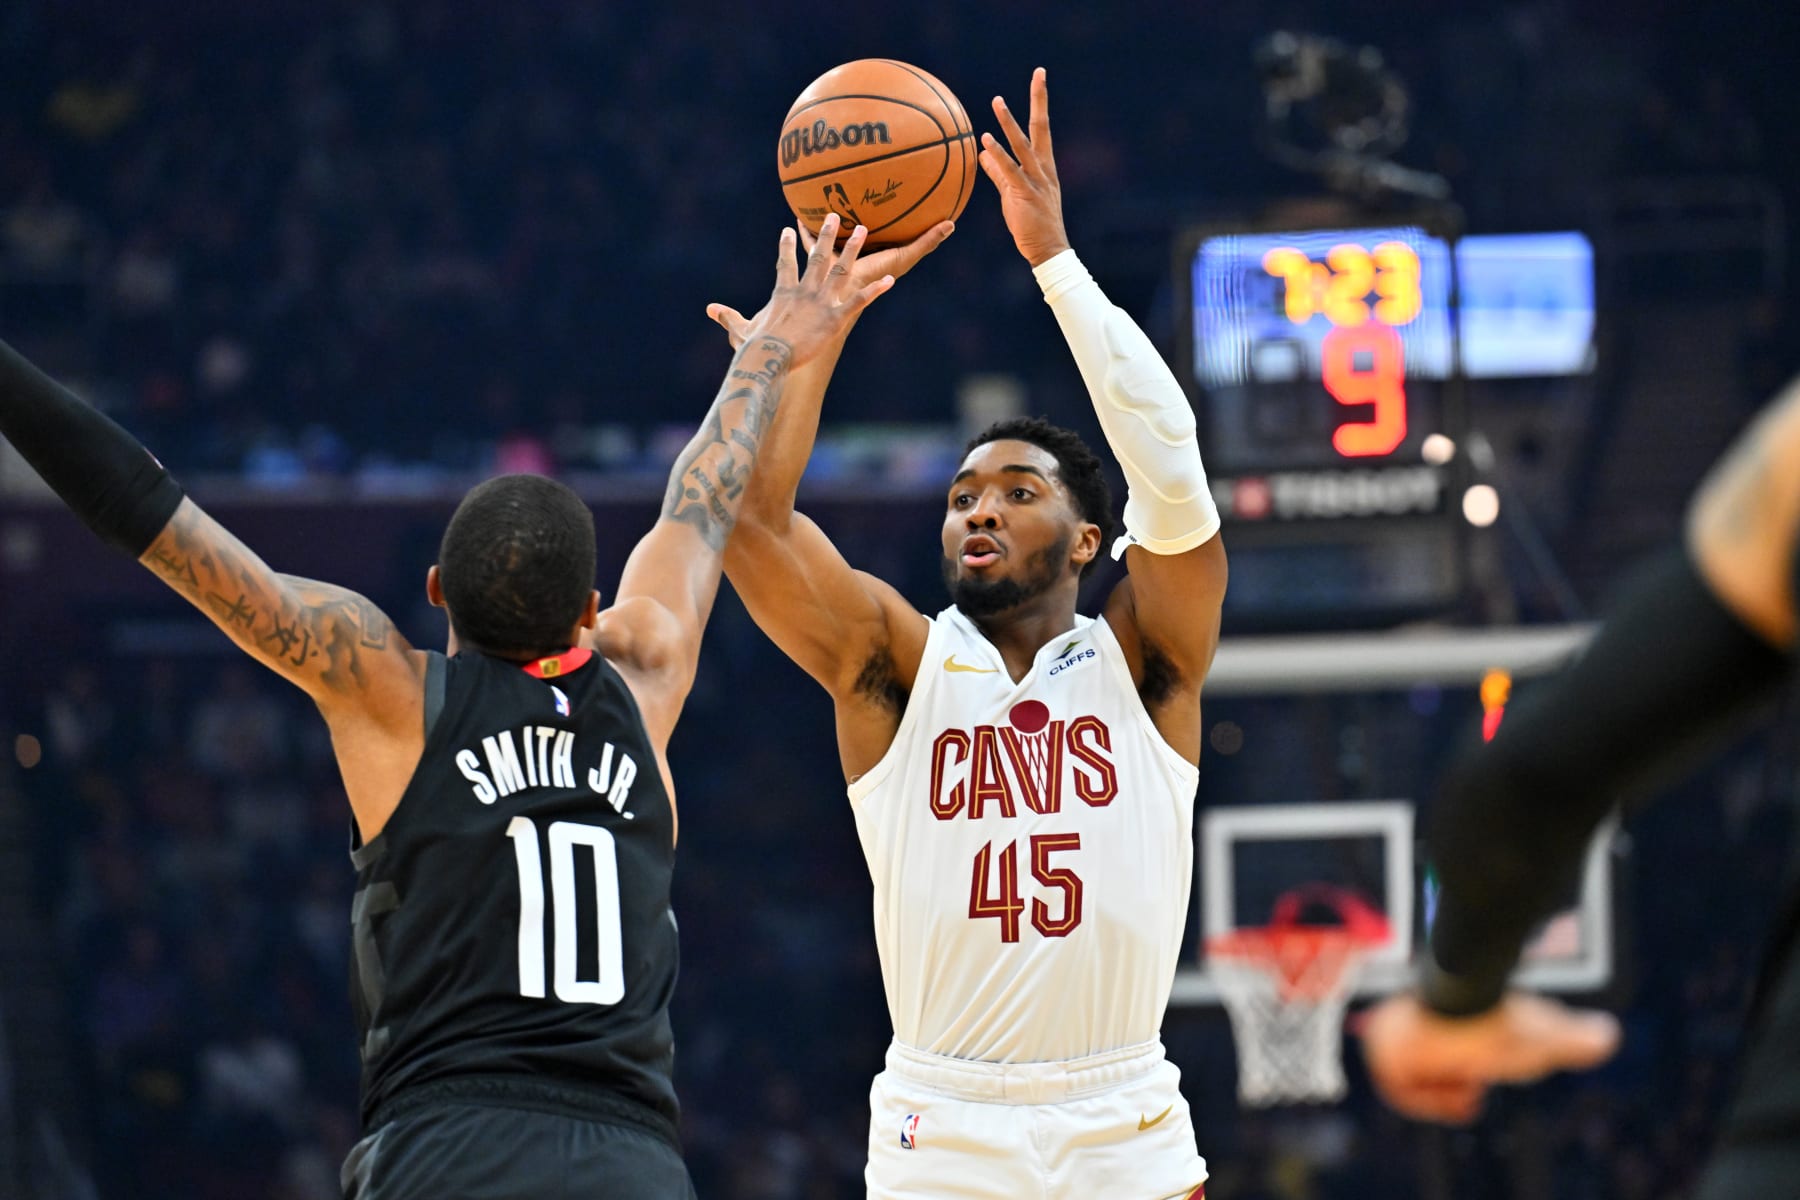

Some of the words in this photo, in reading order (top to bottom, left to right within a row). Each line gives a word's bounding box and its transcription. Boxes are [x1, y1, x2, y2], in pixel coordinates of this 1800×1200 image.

[780, 118, 892, 168] Wilson
[1262, 242, 1422, 328] 7:23
[1321, 319, 1407, 457] 9
[1049, 648, 1096, 676] CLIFFS
[455, 725, 577, 805] SMITH
[588, 742, 638, 820] JR.
[930, 714, 1119, 821] CAVS
[505, 815, 625, 1006] 10
[968, 832, 1083, 943] 45
